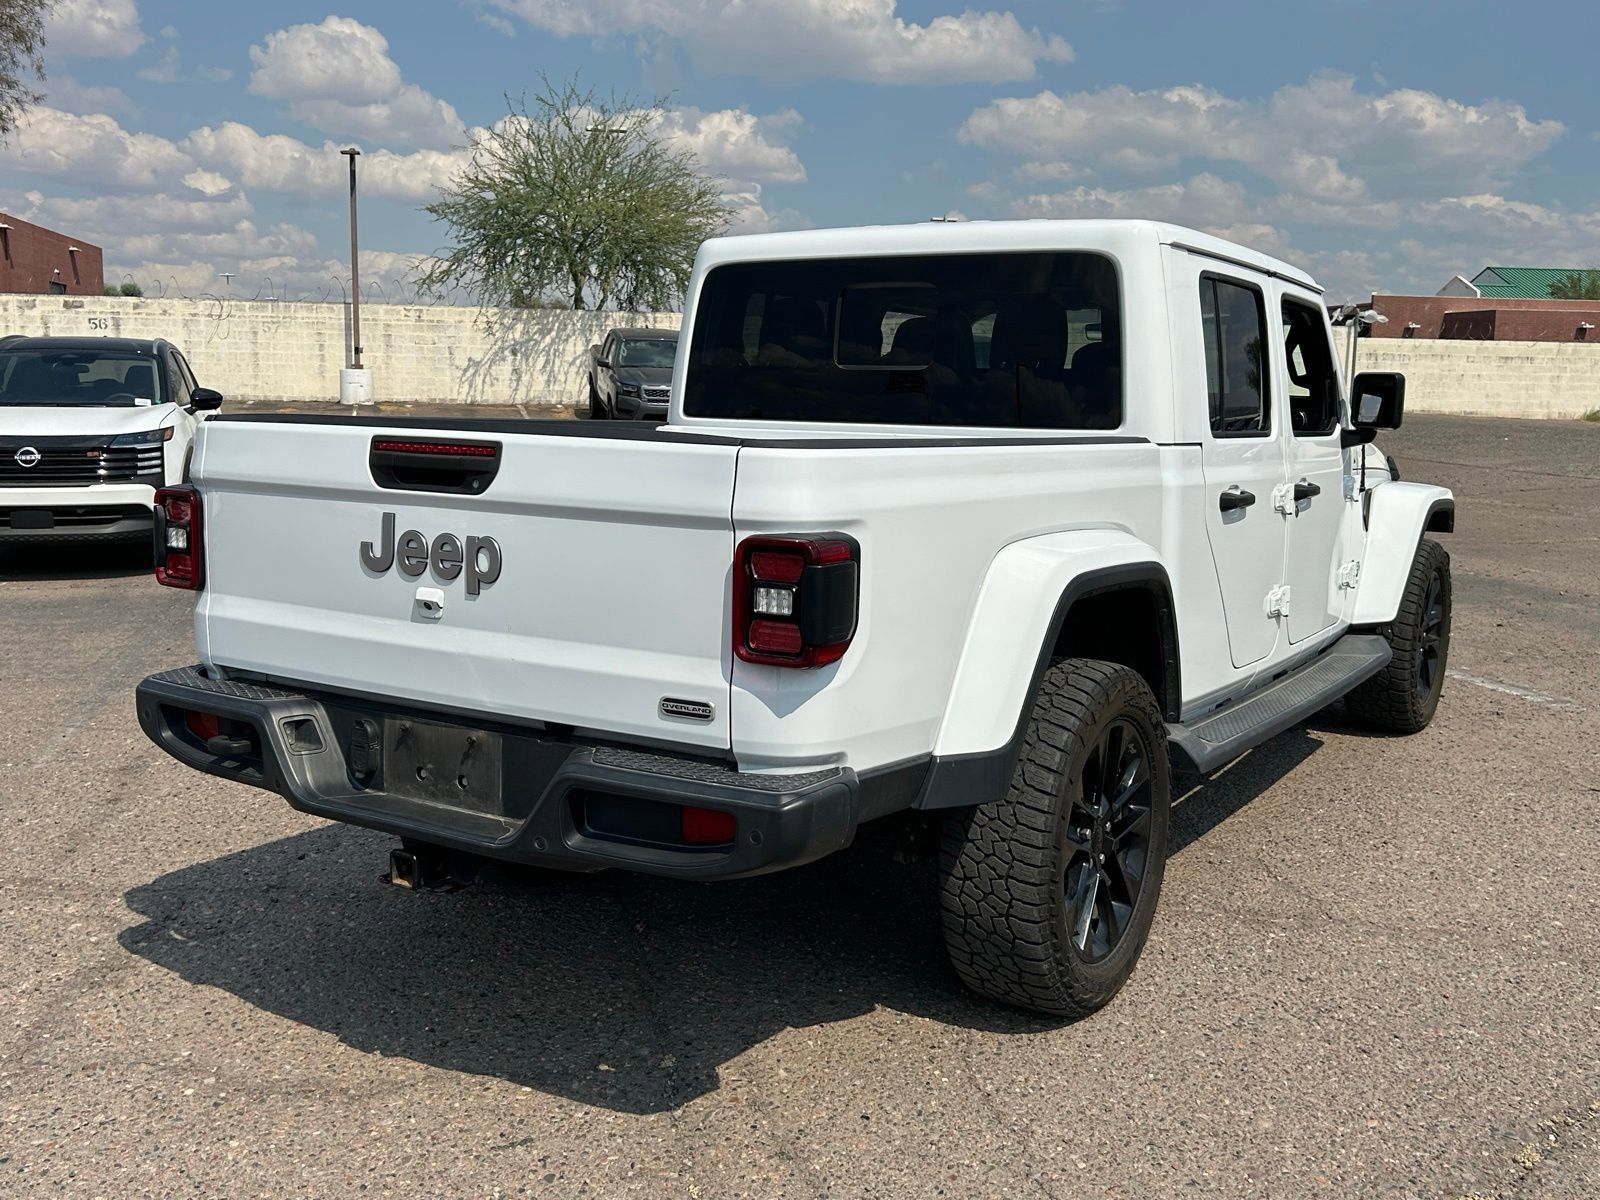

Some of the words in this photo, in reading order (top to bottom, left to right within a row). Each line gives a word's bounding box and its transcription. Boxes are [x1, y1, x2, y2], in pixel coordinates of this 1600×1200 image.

[88, 318, 108, 330] 56
[360, 511, 502, 596] Jeep
[661, 702, 712, 714] OVERLAND
